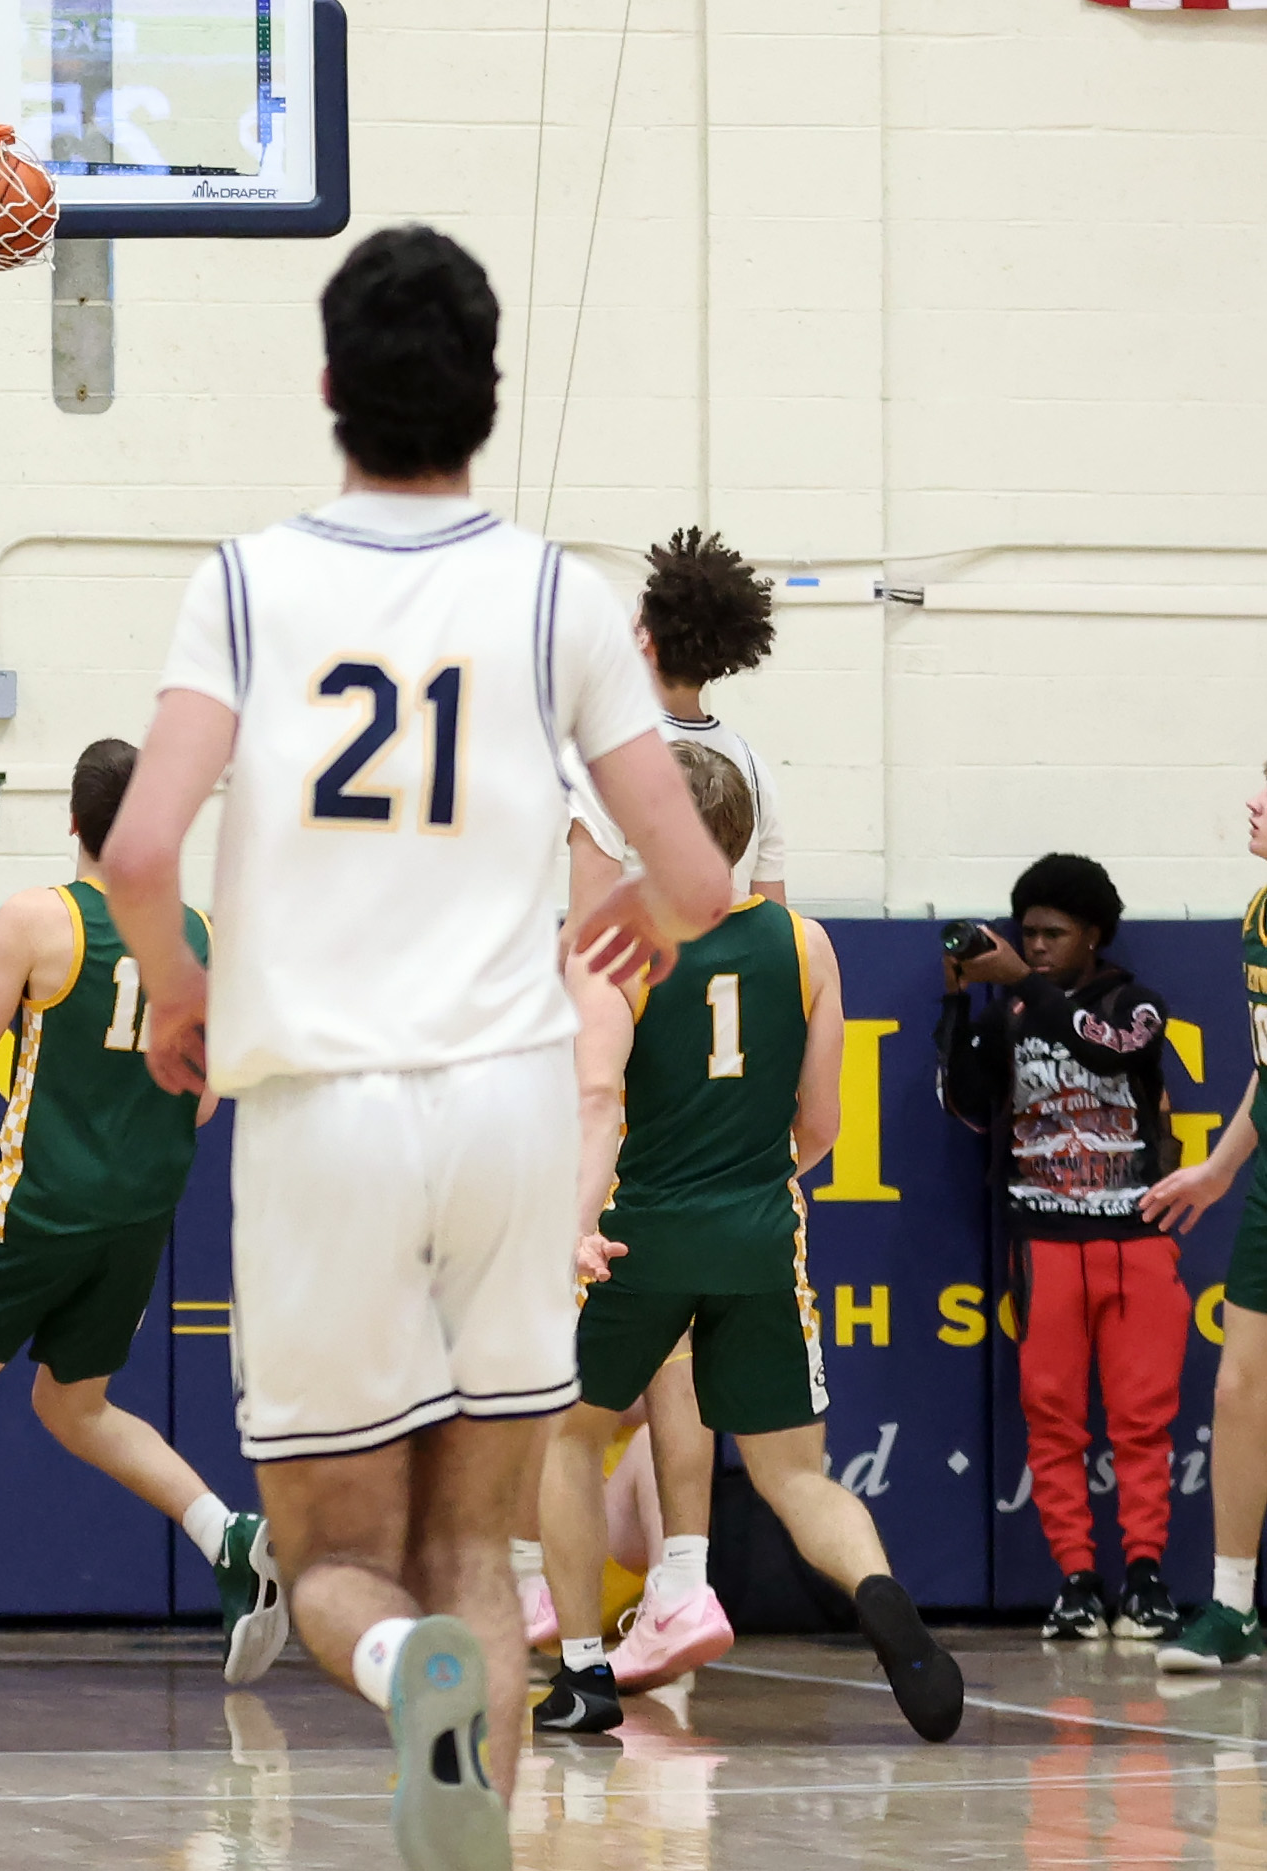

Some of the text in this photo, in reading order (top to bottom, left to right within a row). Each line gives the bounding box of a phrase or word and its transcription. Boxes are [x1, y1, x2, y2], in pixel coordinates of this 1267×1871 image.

[220, 188, 276, 199] DRAPER
[300, 652, 472, 837] 21
[102, 955, 153, 1054] 1
[706, 974, 745, 1079] 1
